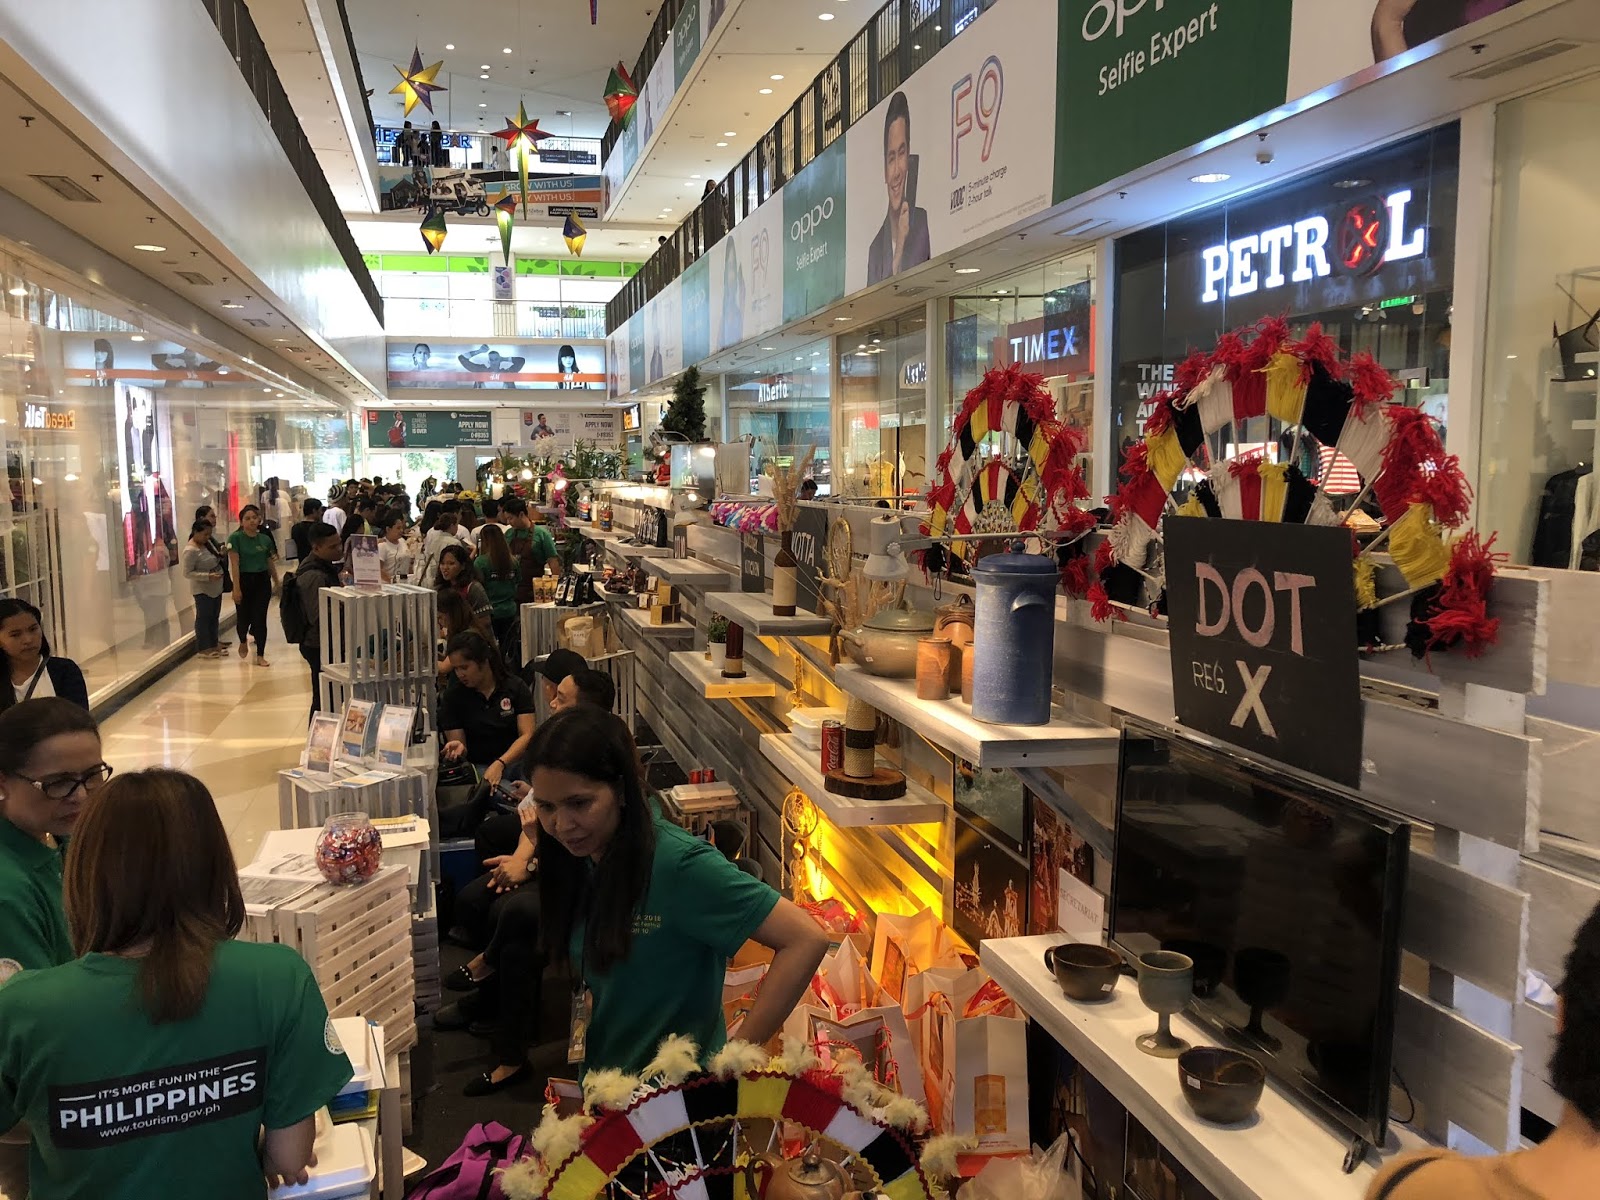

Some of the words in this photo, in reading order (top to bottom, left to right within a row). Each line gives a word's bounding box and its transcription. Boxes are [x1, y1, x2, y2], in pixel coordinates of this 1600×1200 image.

[1098, 50, 1145, 96] Selfie
[1150, 2, 1218, 66] Expert
[951, 55, 1004, 180] F9
[533, 193, 557, 201] WITH
[534, 180, 558, 189] WITH
[560, 179, 573, 188] US
[967, 191, 983, 207] 2-hour
[984, 185, 993, 199] talk
[968, 175, 989, 192] 5-minute
[989, 166, 1007, 179] charge
[791, 197, 834, 243] oppo
[796, 255, 810, 271] Selfie
[810, 241, 828, 264] Expert
[1202, 190, 1424, 303] PETROL
[1010, 326, 1077, 363] TIMEX
[1138, 364, 1174, 381] THE
[458, 421, 474, 429] APPLY
[475, 421, 489, 429] NOW!
[1195, 562, 1316, 656] DOT
[1192, 659, 1228, 695] REG.
[1230, 660, 1278, 738] X
[122, 1081, 156, 1095] MORE
[159, 1076, 182, 1087] FUN
[185, 1073, 197, 1083] IN
[198, 1067, 220, 1080] THE
[60, 1071, 257, 1130] PHILIPPINES
[99, 1102, 221, 1138] www.tourism.gov.ph
